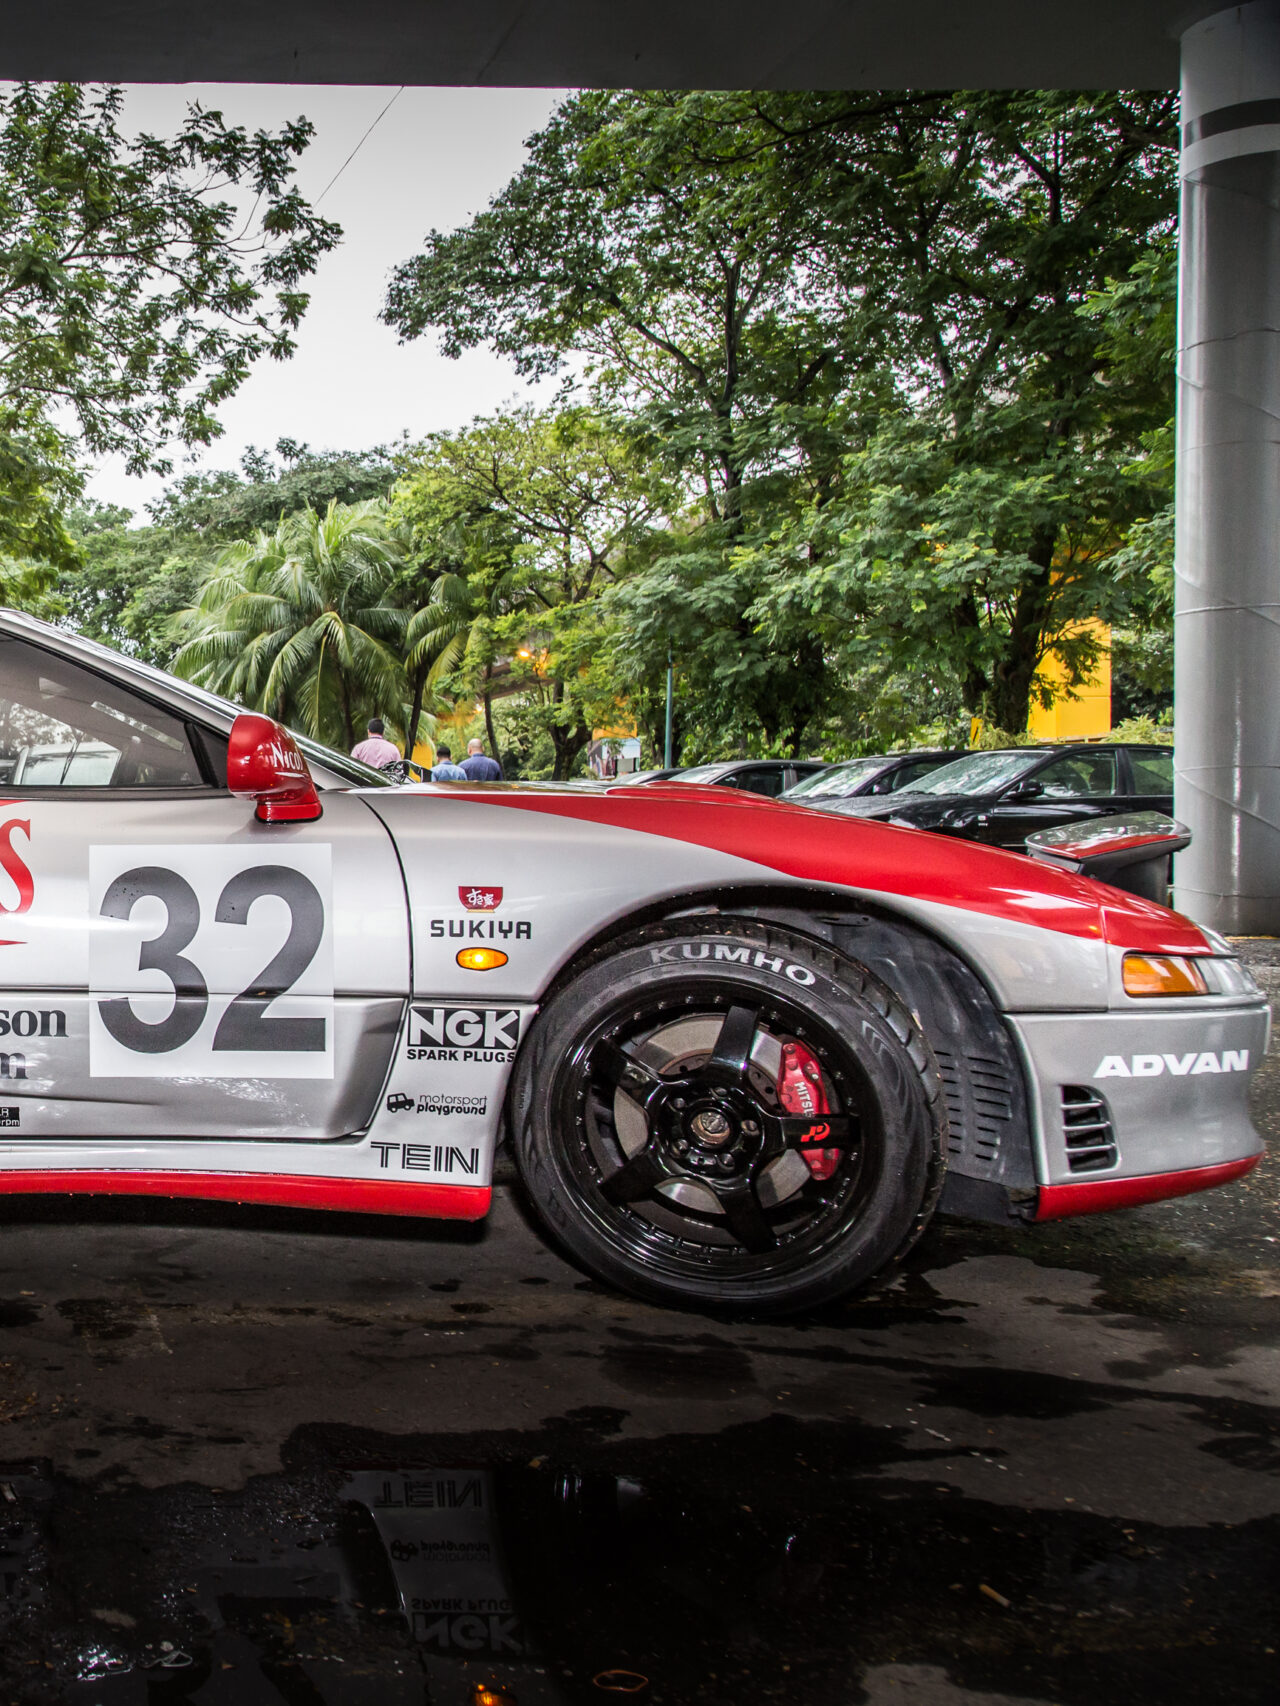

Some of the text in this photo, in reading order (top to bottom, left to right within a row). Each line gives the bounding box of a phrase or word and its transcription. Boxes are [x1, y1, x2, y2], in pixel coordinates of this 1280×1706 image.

[430, 919, 532, 940] SUKIYA
[97, 864, 327, 1054] 32
[650, 943, 817, 986] KUMHO
[408, 1008, 519, 1050] NGK
[406, 1049, 516, 1063] SPARK PLUGS
[1092, 1049, 1250, 1079] ADVAN
[416, 1102, 487, 1116] playground
[419, 1093, 488, 1106] motorsport
[370, 1140, 480, 1175] TEIN
